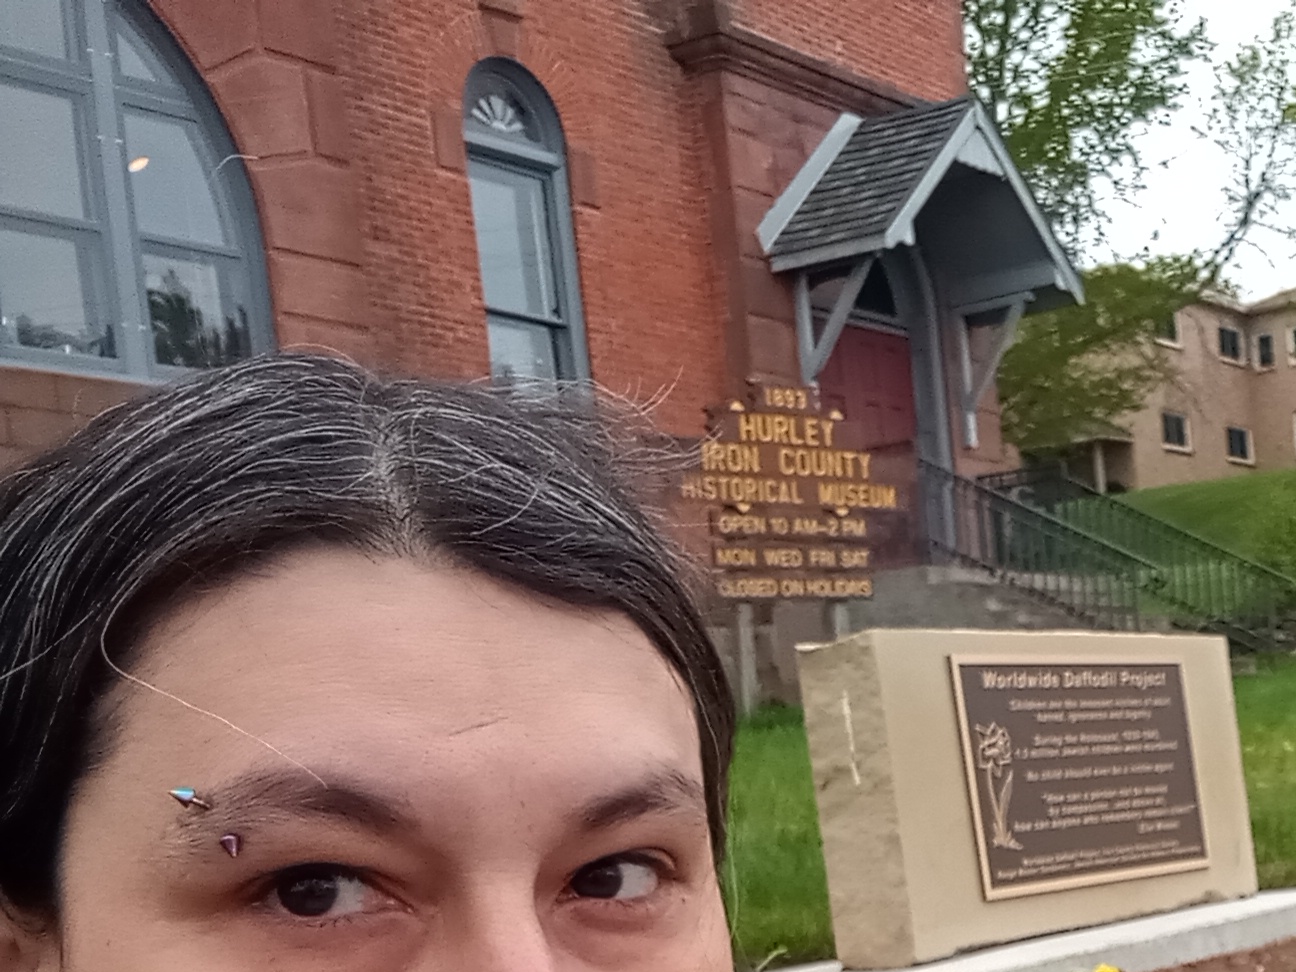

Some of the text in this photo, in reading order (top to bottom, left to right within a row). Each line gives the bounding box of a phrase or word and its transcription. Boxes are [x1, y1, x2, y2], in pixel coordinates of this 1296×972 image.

[765, 387, 807, 409] 1893
[739, 414, 834, 447] HURLEY
[702, 443, 761, 473] IRON
[779, 448, 871, 479] COUNTY
[818, 481, 896, 509] MUSEUM
[718, 515, 767, 535] OPEN
[769, 517, 789, 535] 10
[841, 519, 867, 537] PM
[716, 548, 870, 568] MON WED FRI SAT
[718, 578, 778, 598] CLOSED
[780, 579, 804, 597] ON
[982, 670, 1166, 690] Worldwide Daffodil Project
